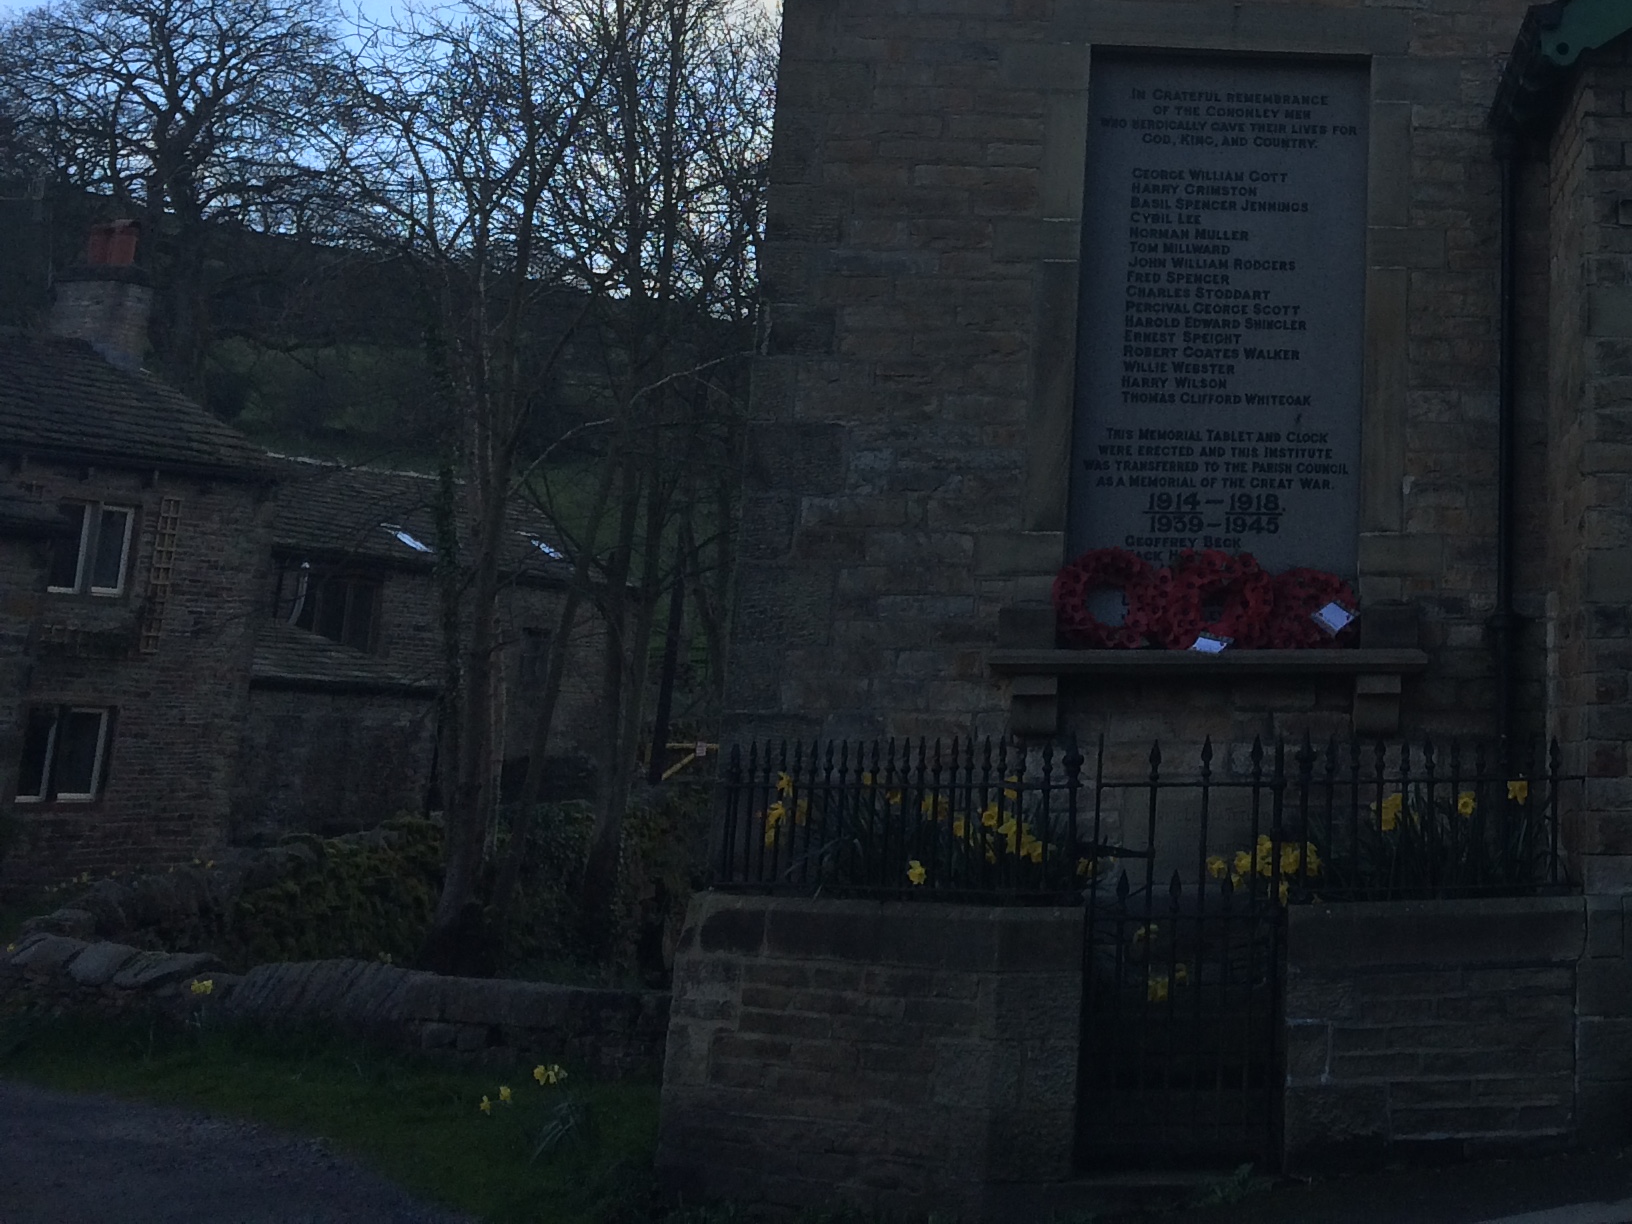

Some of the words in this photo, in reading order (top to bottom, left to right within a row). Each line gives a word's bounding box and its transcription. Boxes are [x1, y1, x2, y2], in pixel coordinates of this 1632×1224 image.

[1131, 88, 1146, 100] IN
[1152, 89, 1222, 102] GRATEFUL
[1226, 92, 1329, 106] REMEMBRANCE
[1152, 106, 1169, 116] OF
[1174, 106, 1200, 117] THE
[1284, 109, 1311, 120] MEN
[1100, 117, 1127, 129] WHO
[1211, 121, 1246, 132] GAVE
[1250, 122, 1287, 134] THEIR
[1291, 124, 1328, 135] LIVES
[1332, 126, 1358, 136] FOR
[1221, 135, 1248, 147] AND
[1131, 167, 1185, 180] GEORGE
[1189, 169, 1244, 182] WILLIAM
[1132, 182, 1180, 195] HARRY
[1130, 196, 1171, 209] BASIL
[1175, 197, 1237, 211] SPENCER
[1241, 199, 1309, 213] JENNINGS
[1177, 212, 1202, 225] LEE
[1129, 226, 1190, 240] NORMAN
[1130, 241, 1158, 253] TOM
[1163, 242, 1231, 255] MILLWARD
[1128, 256, 1167, 269] JOHN
[1171, 257, 1229, 270] WILLIAM
[1233, 258, 1296, 271] RODGERS
[1127, 270, 1161, 283] FRED
[1166, 271, 1230, 285] SPENCER
[1126, 285, 1191, 299] CHARLES
[1195, 286, 1271, 301] STODDART
[1125, 300, 1190, 314] PERCIVAL
[1193, 302, 1249, 315] GEORGE
[1253, 303, 1300, 316] SCOTT
[1125, 315, 1180, 328] HAROLD
[1184, 316, 1241, 329] EDWARD
[1124, 329, 1176, 343] ERNEST
[1182, 330, 1242, 344] SPEIGHT
[1123, 344, 1178, 358] ROBERT
[1243, 347, 1300, 360] WALKER
[1123, 360, 1167, 373] WILLIE
[1171, 361, 1235, 375] WEBSTER
[1121, 375, 1168, 388] HARRY
[1175, 377, 1227, 389] WILSON
[1121, 391, 1176, 404] THOMAS
[1180, 392, 1242, 405] CLIFFORD
[1245, 393, 1311, 406] WHITEOAK
[1106, 427, 1133, 440] THIS
[1138, 428, 1202, 441] MEMORIAL
[1206, 429, 1252, 442] TABLET
[1256, 432, 1281, 443] AND
[1286, 431, 1329, 444] CLOCK
[1098, 445, 1133, 456] WERE
[1138, 445, 1194, 457] ERECTED
[1199, 446, 1226, 458] AND
[1231, 446, 1258, 458] THIS
[1263, 446, 1333, 460] INSTITUTE
[1083, 460, 1110, 471] WAS
[1116, 460, 1199, 472] TRANSFERRED
[1204, 461, 1220, 473] TO
[1225, 462, 1248, 473] THE
[1252, 461, 1292, 474] PARISH
[1296, 462, 1349, 475] COUNCIL
[1129, 475, 1196, 488] MEMORIAL
[1200, 477, 1218, 489] OF
[1221, 477, 1246, 489] THE
[1250, 477, 1294, 490] GREAT
[1125, 535, 1196, 550] GEOFFREY
[1203, 535, 1242, 549] BECK
[1130, 549, 1164, 562] ACK
